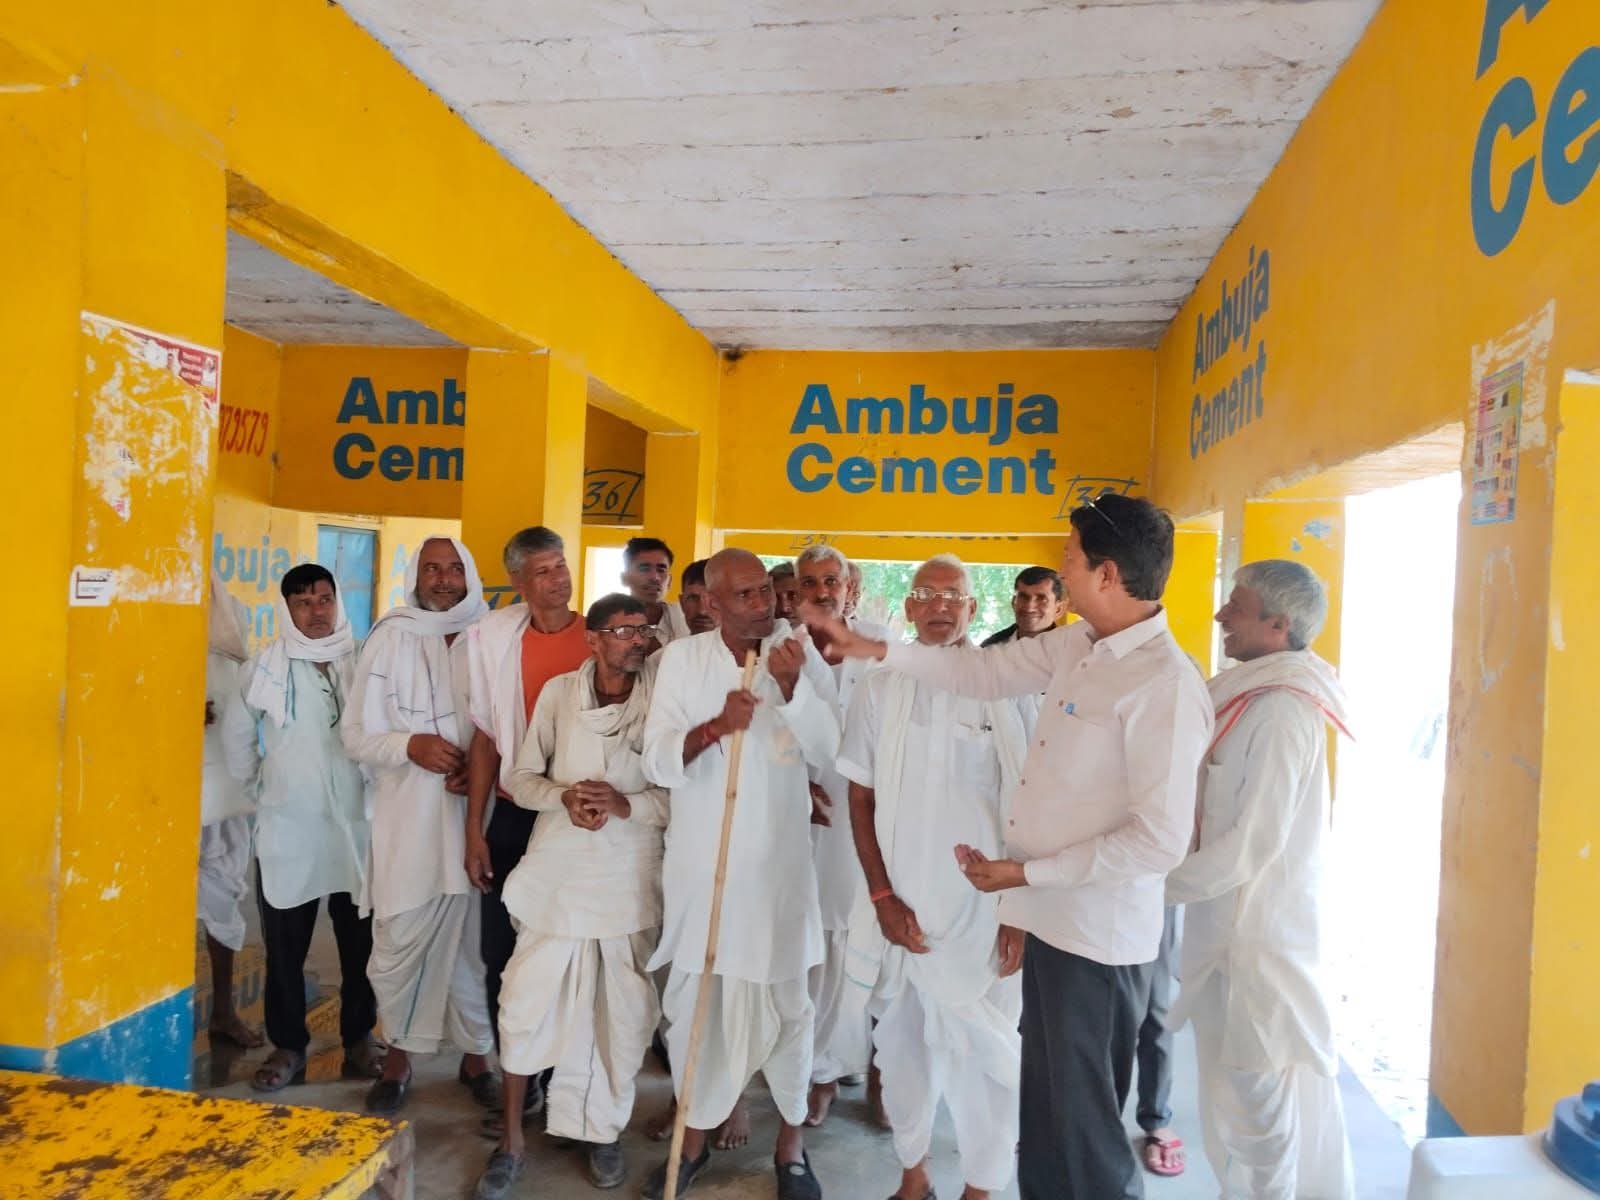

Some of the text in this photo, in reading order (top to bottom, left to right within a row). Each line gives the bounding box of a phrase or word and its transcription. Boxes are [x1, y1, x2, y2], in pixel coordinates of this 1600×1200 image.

[1192, 244, 1270, 385] Ambuja
[790, 383, 1059, 446] Ambuja
[1190, 338, 1267, 461] Cement
[333, 432, 464, 482] Cem
[786, 442, 1057, 496] Cement
